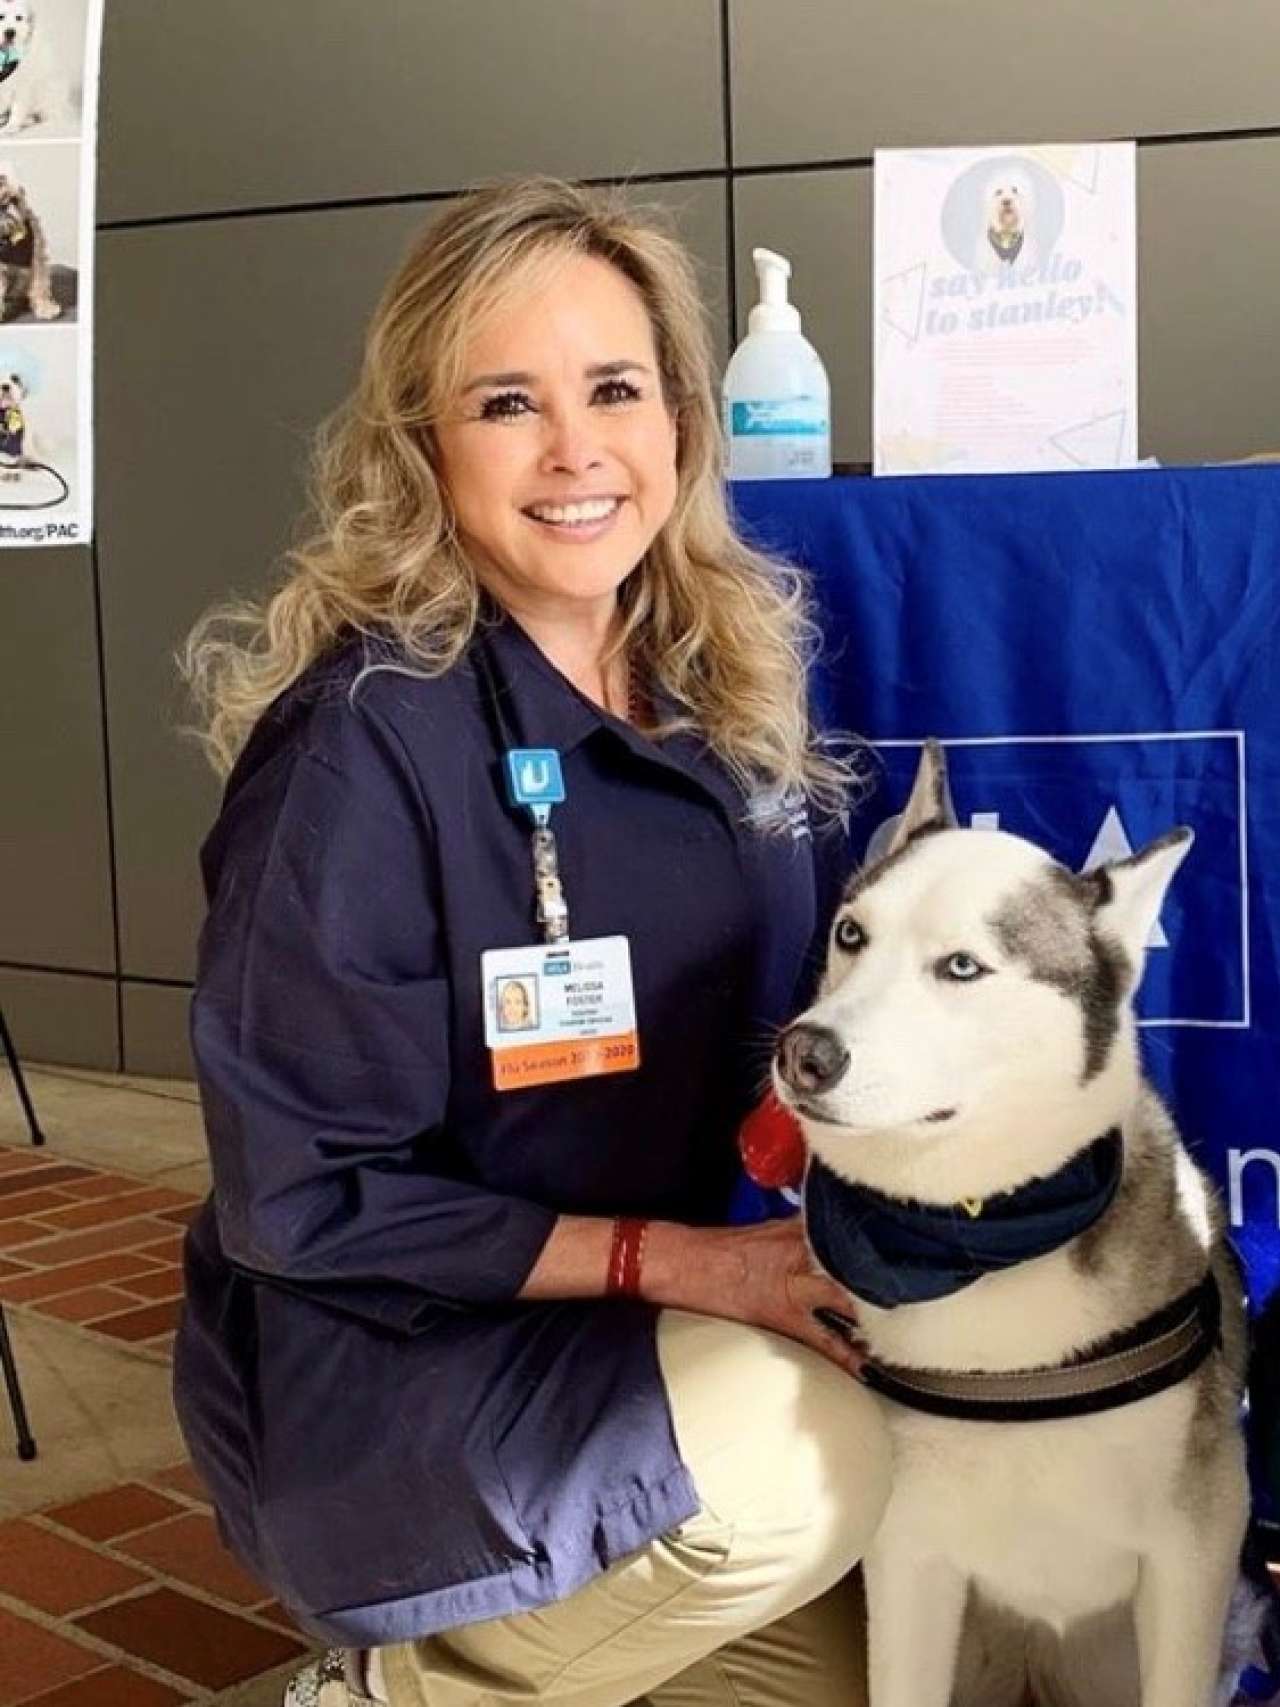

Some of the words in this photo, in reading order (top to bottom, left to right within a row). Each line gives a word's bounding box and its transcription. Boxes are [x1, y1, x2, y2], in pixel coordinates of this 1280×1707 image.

[929, 271, 986, 300] say
[997, 253, 1082, 290] hello
[926, 308, 958, 335] to
